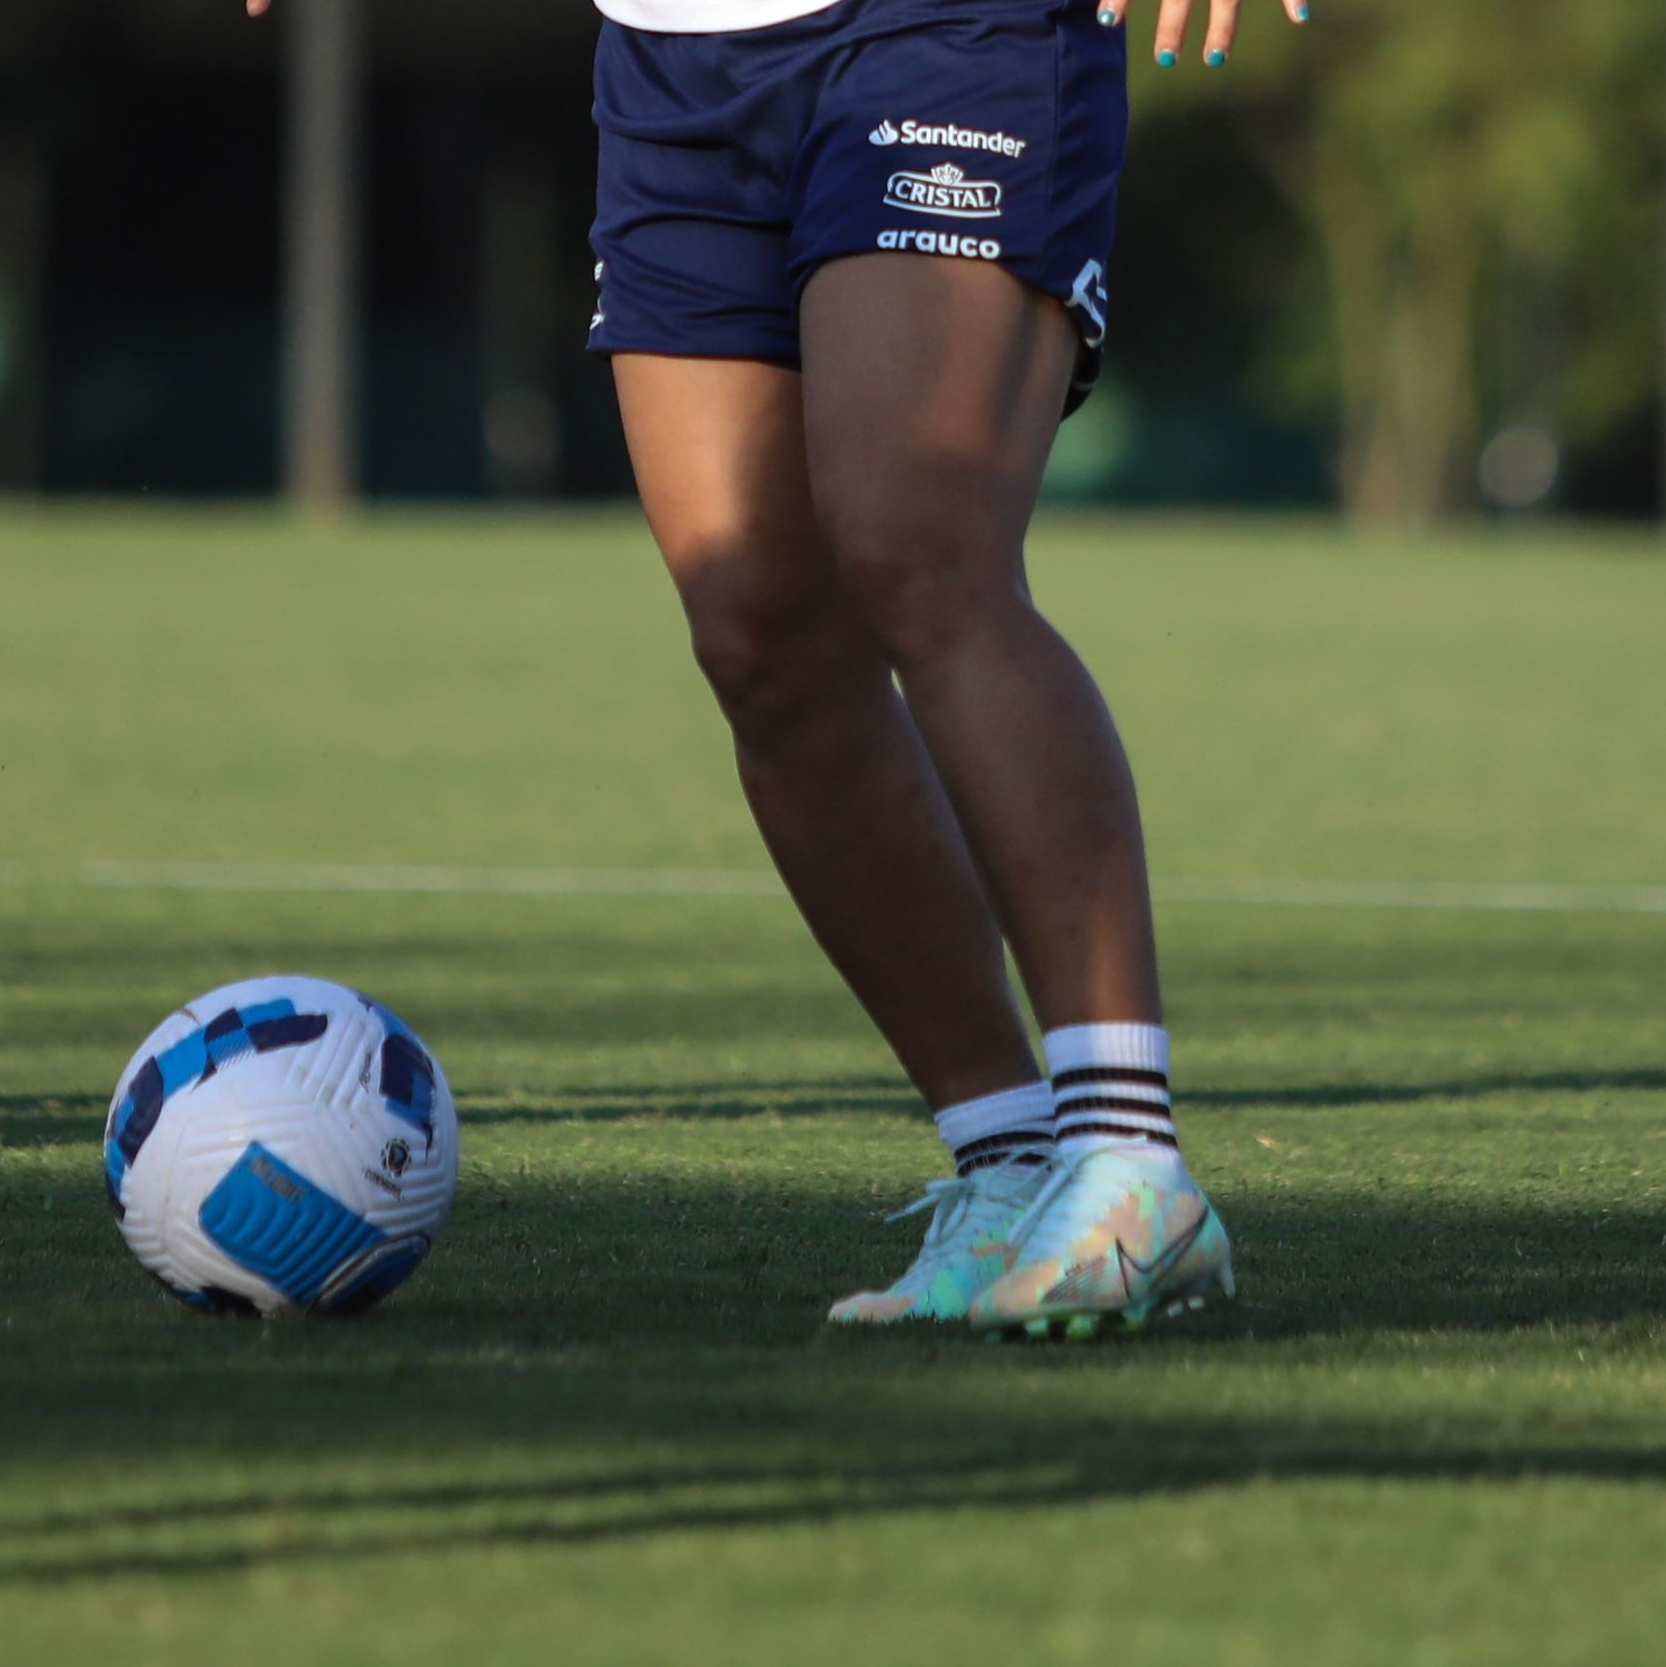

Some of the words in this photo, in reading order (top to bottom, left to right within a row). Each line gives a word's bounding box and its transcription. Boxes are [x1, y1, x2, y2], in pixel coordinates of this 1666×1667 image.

[900, 120, 1026, 159] Santander
[894, 180, 992, 209] CRISTAL
[876, 229, 1001, 260] arauco
